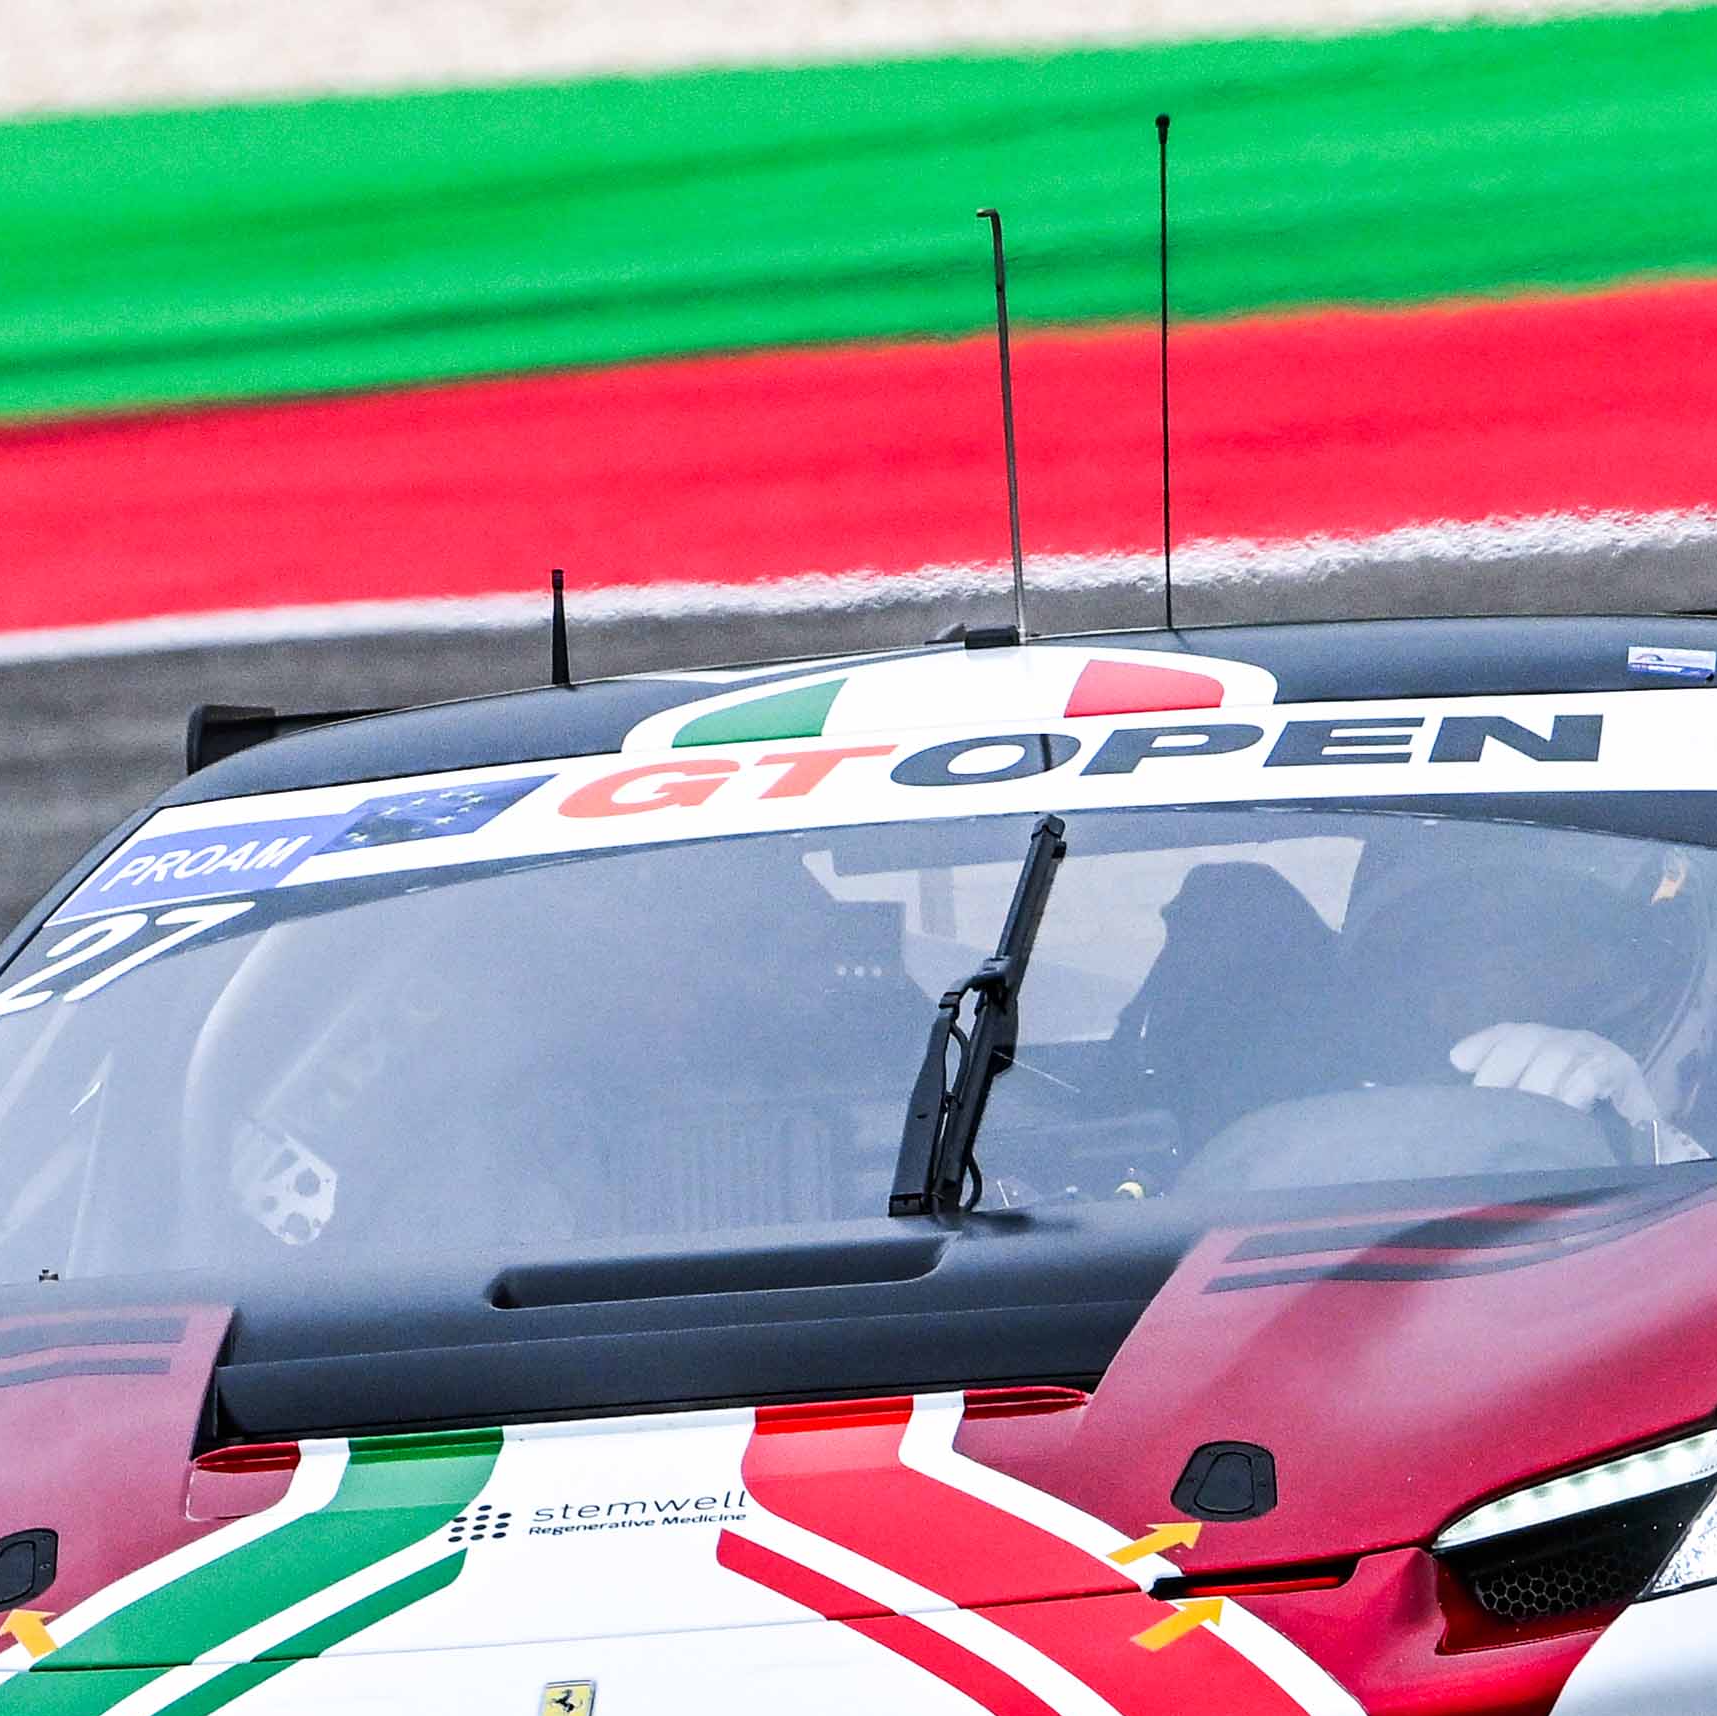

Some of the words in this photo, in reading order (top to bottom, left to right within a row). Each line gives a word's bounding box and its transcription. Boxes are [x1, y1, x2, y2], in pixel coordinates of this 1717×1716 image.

[557, 711, 1604, 819] GTOPEN
[99, 834, 313, 893] PROAM
[528, 1517, 656, 1536] Regenerative
[660, 1511, 747, 1526] Medicine
[532, 1489, 747, 1523] stemwell
